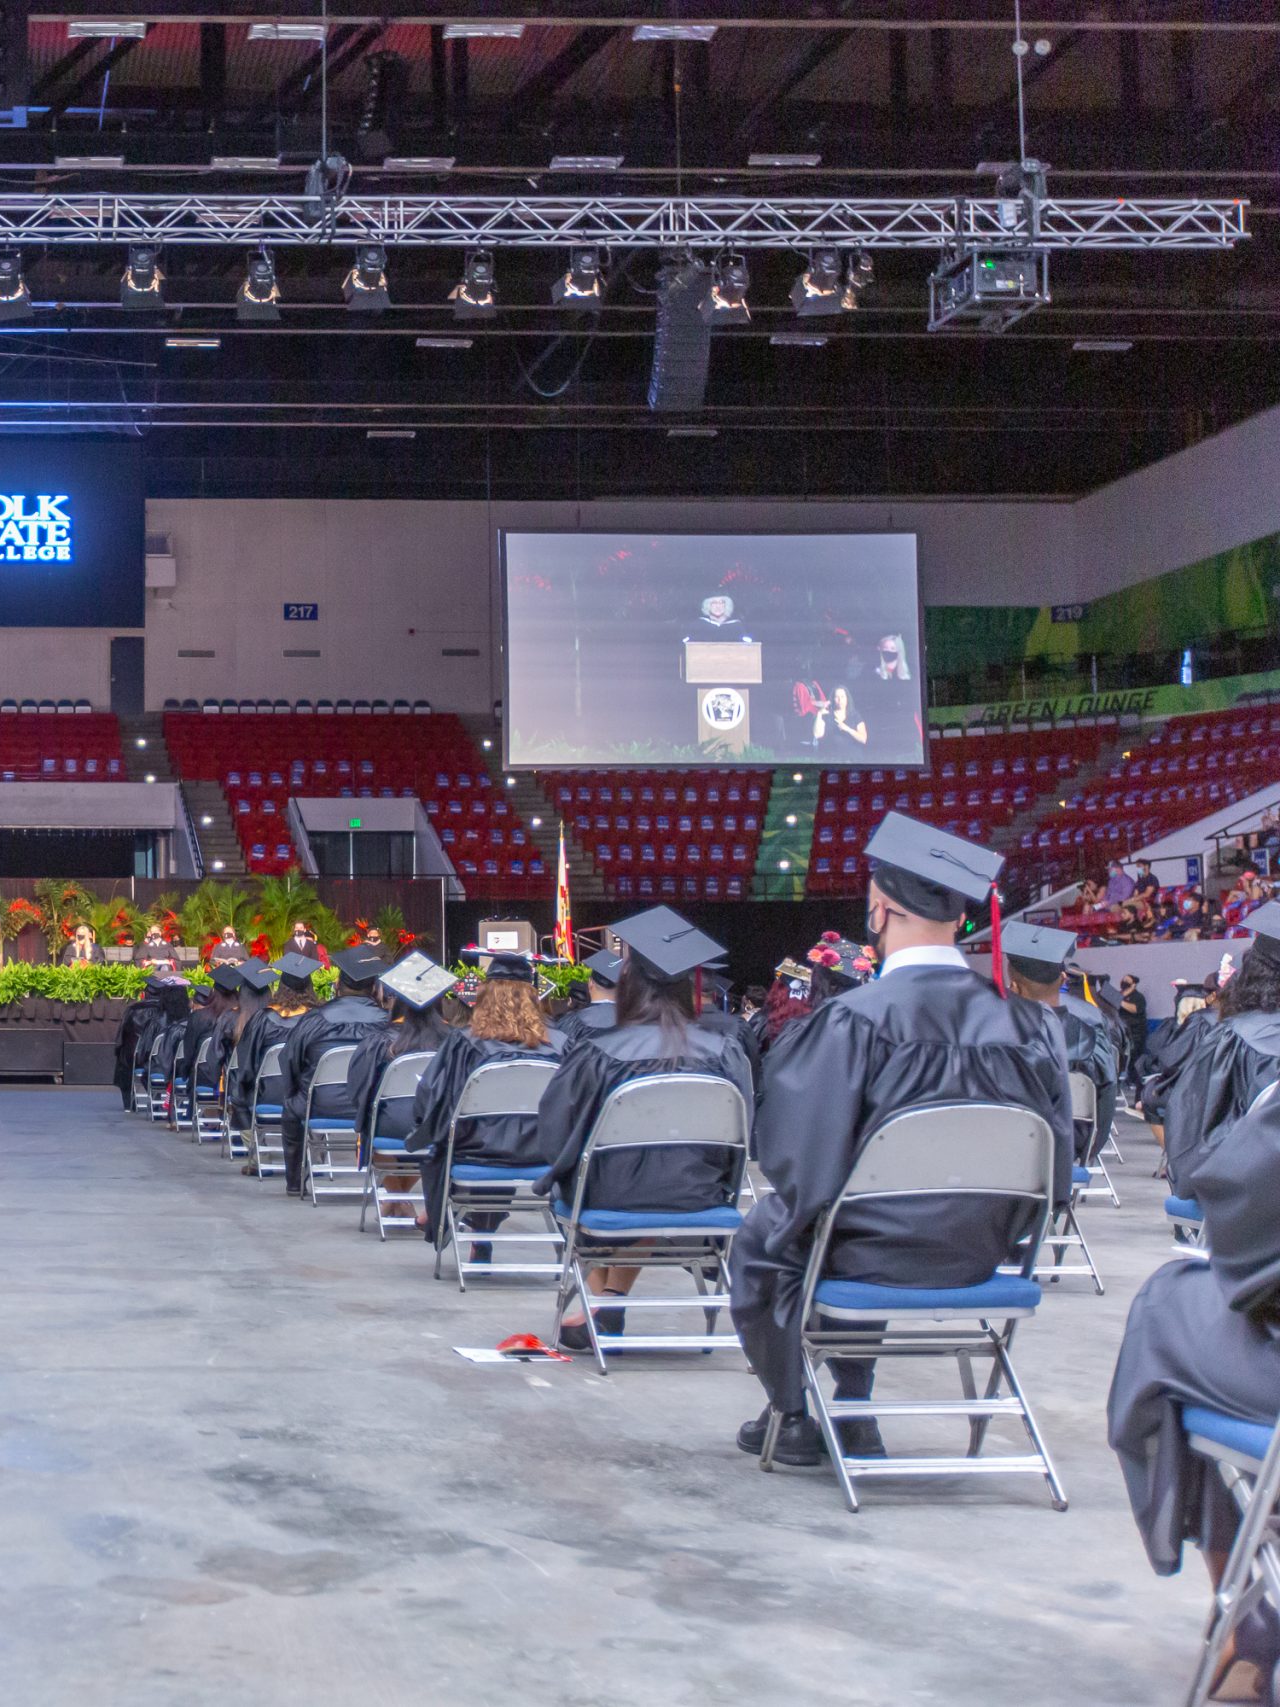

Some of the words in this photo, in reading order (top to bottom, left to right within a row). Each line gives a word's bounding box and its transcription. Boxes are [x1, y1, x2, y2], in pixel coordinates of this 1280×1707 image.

[289, 605, 314, 618] 217
[982, 699, 1059, 724] GREEN
[1064, 690, 1158, 718] LOUNGE
